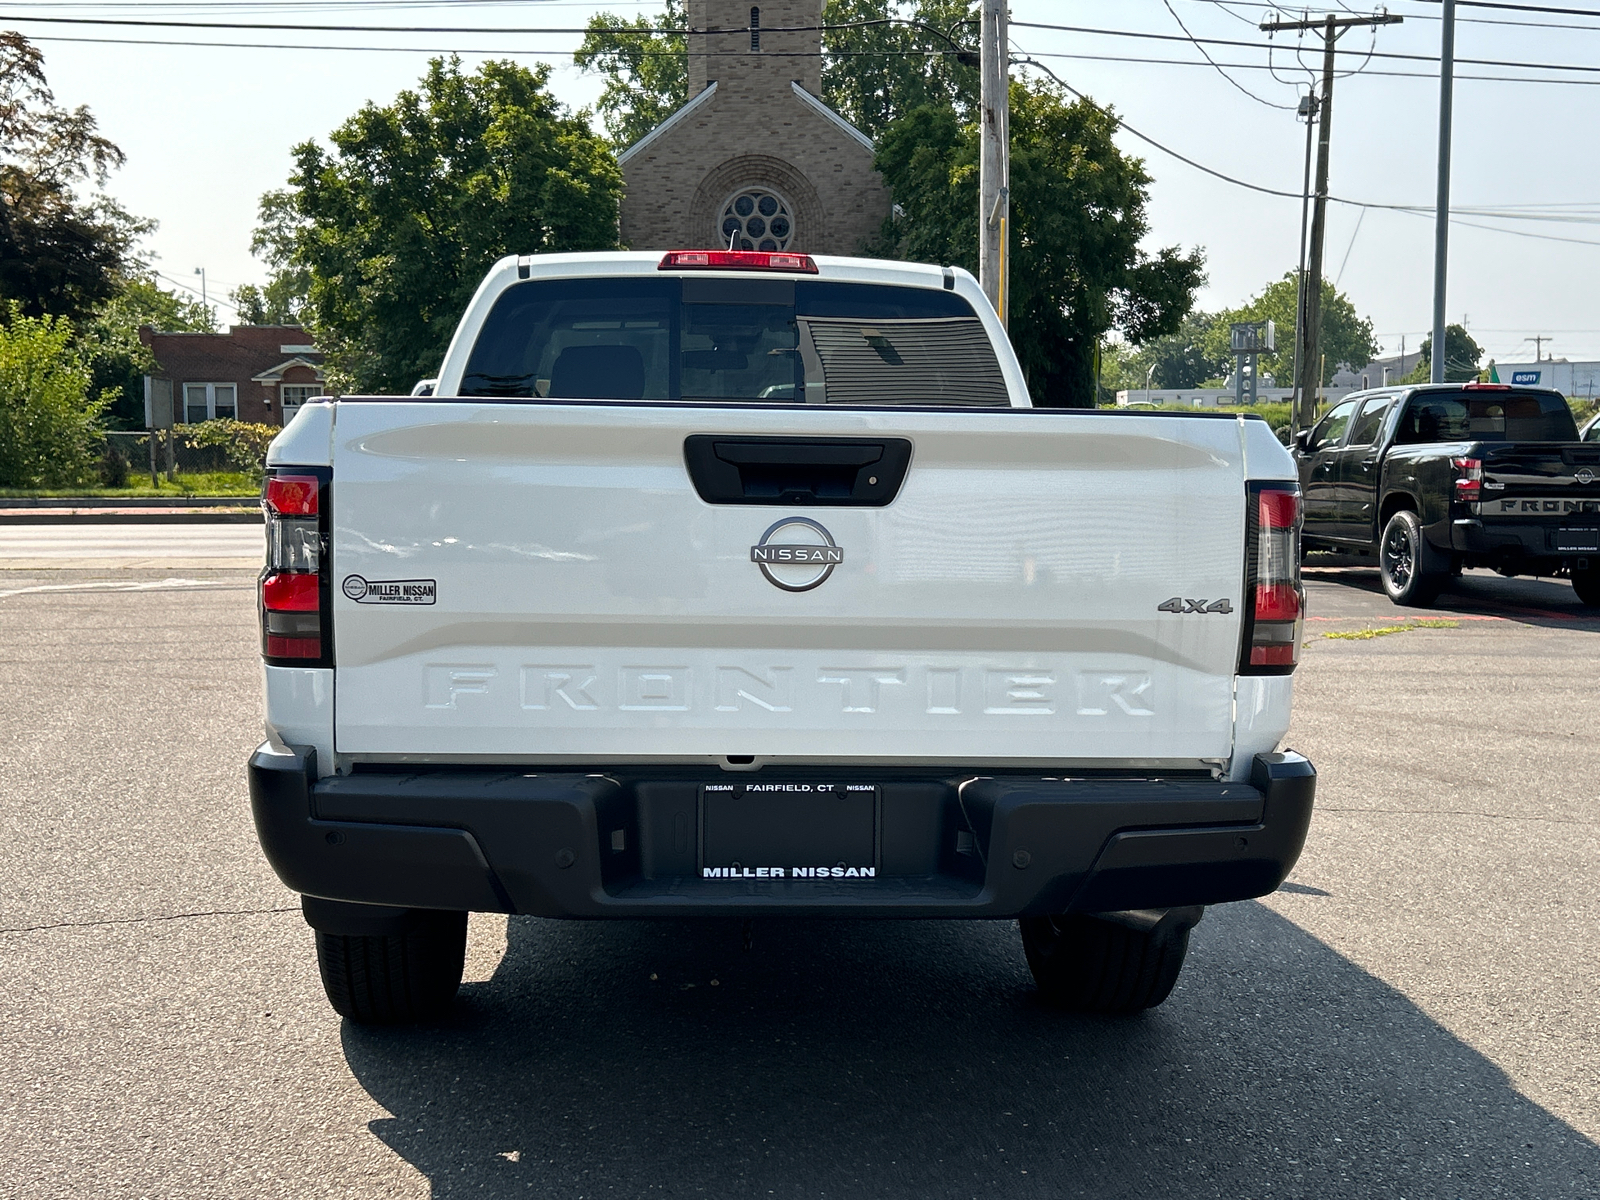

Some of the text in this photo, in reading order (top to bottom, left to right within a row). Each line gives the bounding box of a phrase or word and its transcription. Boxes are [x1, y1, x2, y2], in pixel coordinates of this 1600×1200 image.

[1515, 373, 1536, 382] esm
[754, 548, 840, 561] NISSAN
[368, 585, 434, 596] MILLER NISSAN
[424, 663, 1155, 716] FRONTIER
[746, 784, 814, 793] FAIRFIELD,
[816, 784, 834, 792] CT
[703, 867, 876, 878] MILLER NISSAN
